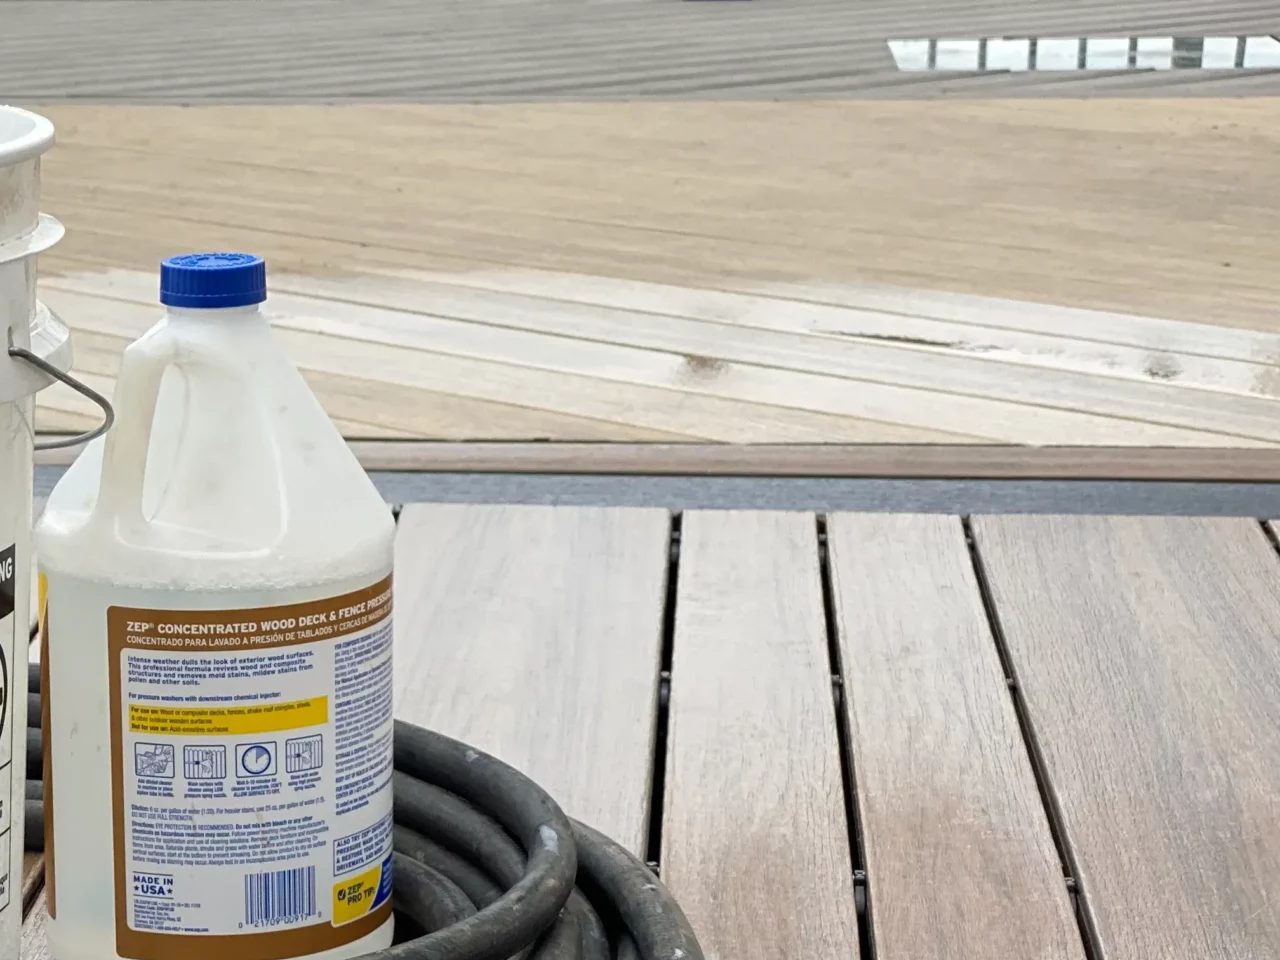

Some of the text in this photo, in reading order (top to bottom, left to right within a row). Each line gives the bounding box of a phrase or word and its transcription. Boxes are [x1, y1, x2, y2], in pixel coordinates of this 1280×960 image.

[158, 622, 257, 634] CONCENTRATED
[261, 619, 296, 632] WOOD
[299, 612, 327, 627] DECK
[329, 611, 337, 621] &
[339, 603, 366, 619] FENCE
[127, 635, 183, 646] CONCENTRADO
[185, 638, 206, 647] PARA
[209, 637, 241, 646] LAVADO
[242, 637, 249, 645] A
[250, 632, 284, 644] PRESIÓN
[286, 632, 295, 640] DE
[297, 626, 332, 639] TABLADOS
[340, 619, 361, 630] CERCAS
[143, 663, 183, 672] professional
[273, 658, 305, 669] composite
[153, 657, 180, 665] weather
[239, 656, 265, 664] exterior
[268, 653, 284, 661] wood
[286, 651, 314, 659] surfaces.
[253, 669, 275, 677] mildew
[277, 666, 297, 674] stains
[299, 663, 313, 671] from
[336, 839, 351, 848] ALSO
[352, 835, 360, 843] TRY
[336, 842, 361, 855] PRESSURE
[342, 848, 363, 861] RESTORE
[133, 875, 173, 886] MADE IN
[141, 884, 166, 895] USA
[348, 892, 362, 906] PRO
[254, 918, 280, 928] 21709
[284, 913, 309, 924] 00917
